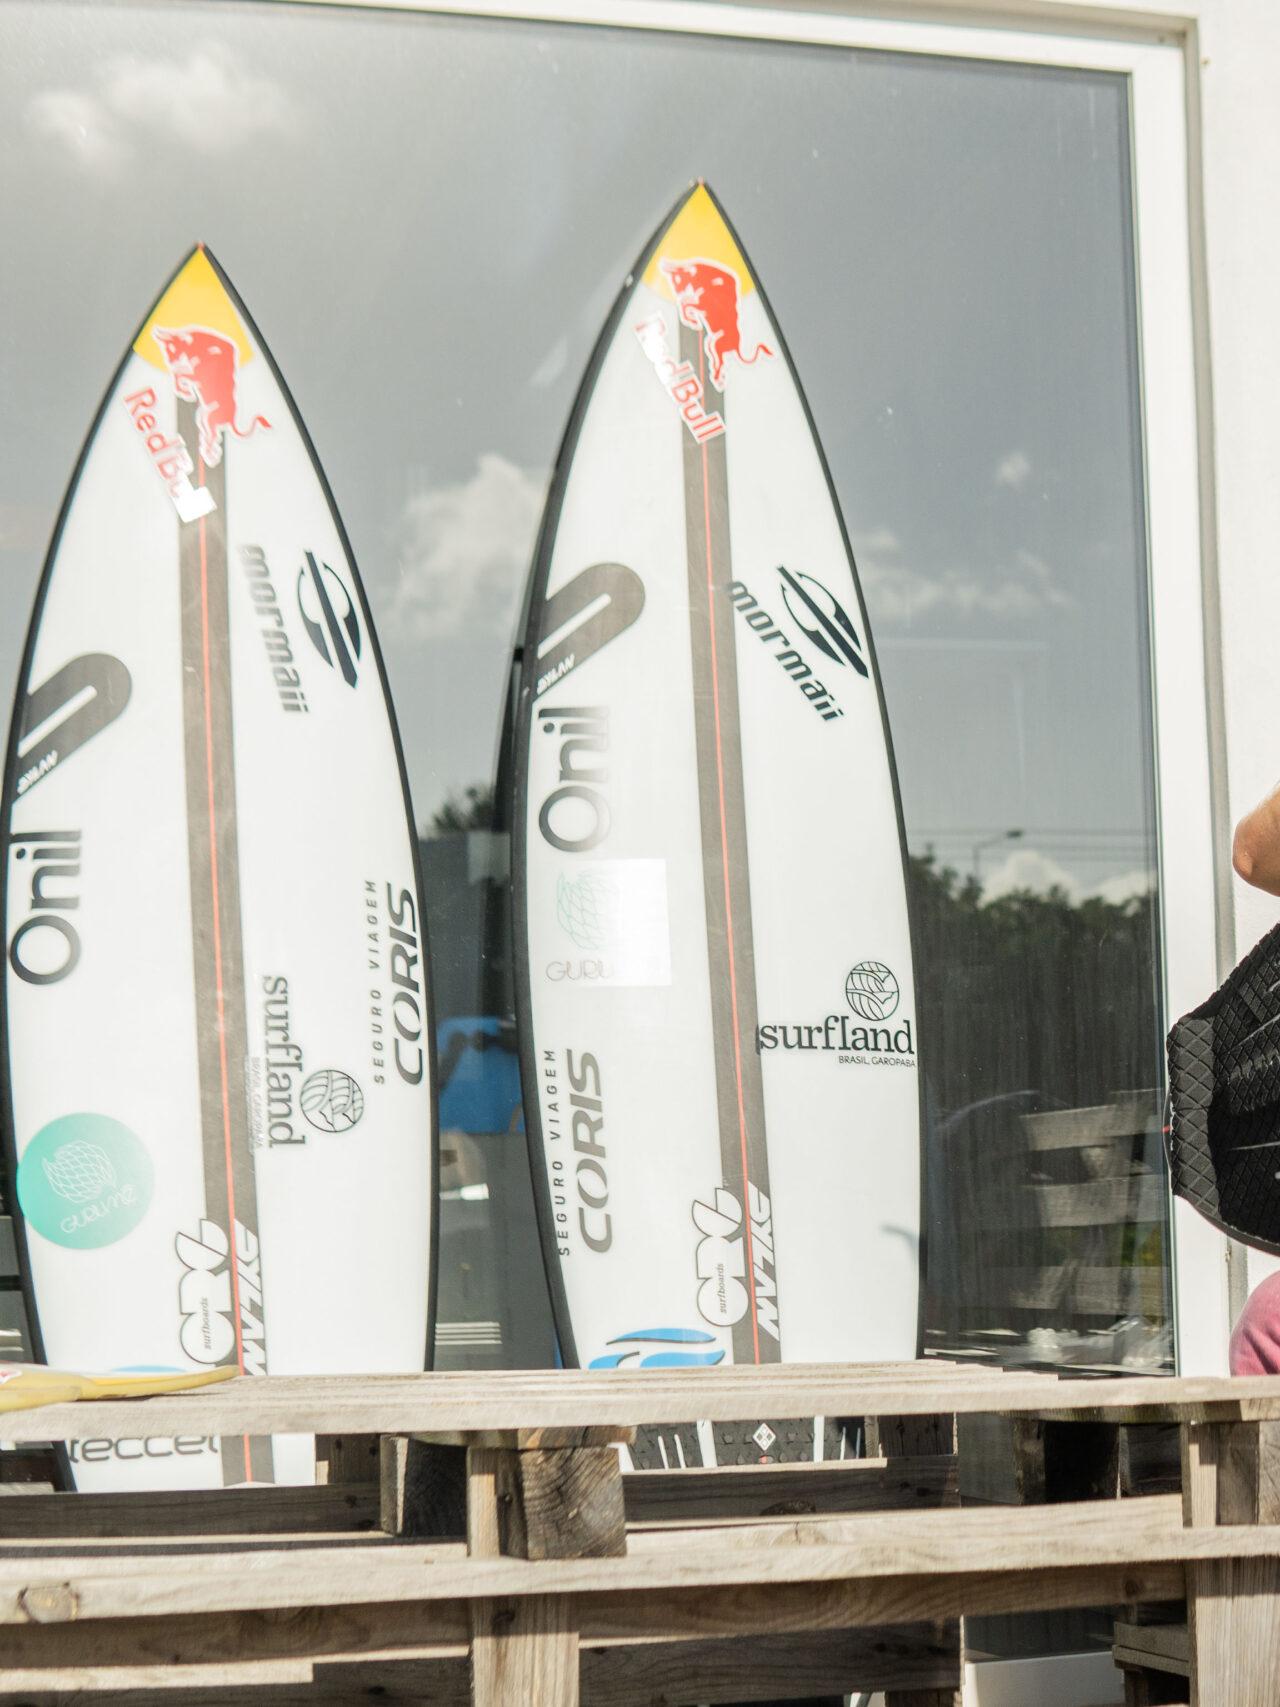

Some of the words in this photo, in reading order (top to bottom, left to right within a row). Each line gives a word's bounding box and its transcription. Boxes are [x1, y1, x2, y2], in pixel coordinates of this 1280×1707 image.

[123, 388, 186, 453] Red
[672, 378, 725, 440] Bull
[240, 543, 309, 714] mormaii
[728, 581, 845, 722] mormaii
[538, 706, 611, 853] Onil
[9, 829, 82, 986] Onil
[364, 880, 381, 971] VIAGEM
[386, 881, 424, 1087] CORIS
[262, 975, 306, 1149] surfland
[371, 989, 385, 1085] SEGURO
[758, 1015, 915, 1056] surfland
[871, 1056, 917, 1068] GAROPABA
[543, 1050, 562, 1141] VIAGEM
[567, 1048, 613, 1254] CORIS
[551, 1160, 571, 1257] SEGURO
[201, 1296, 213, 1350] surfboards
[718, 1263, 728, 1314] surfboards
